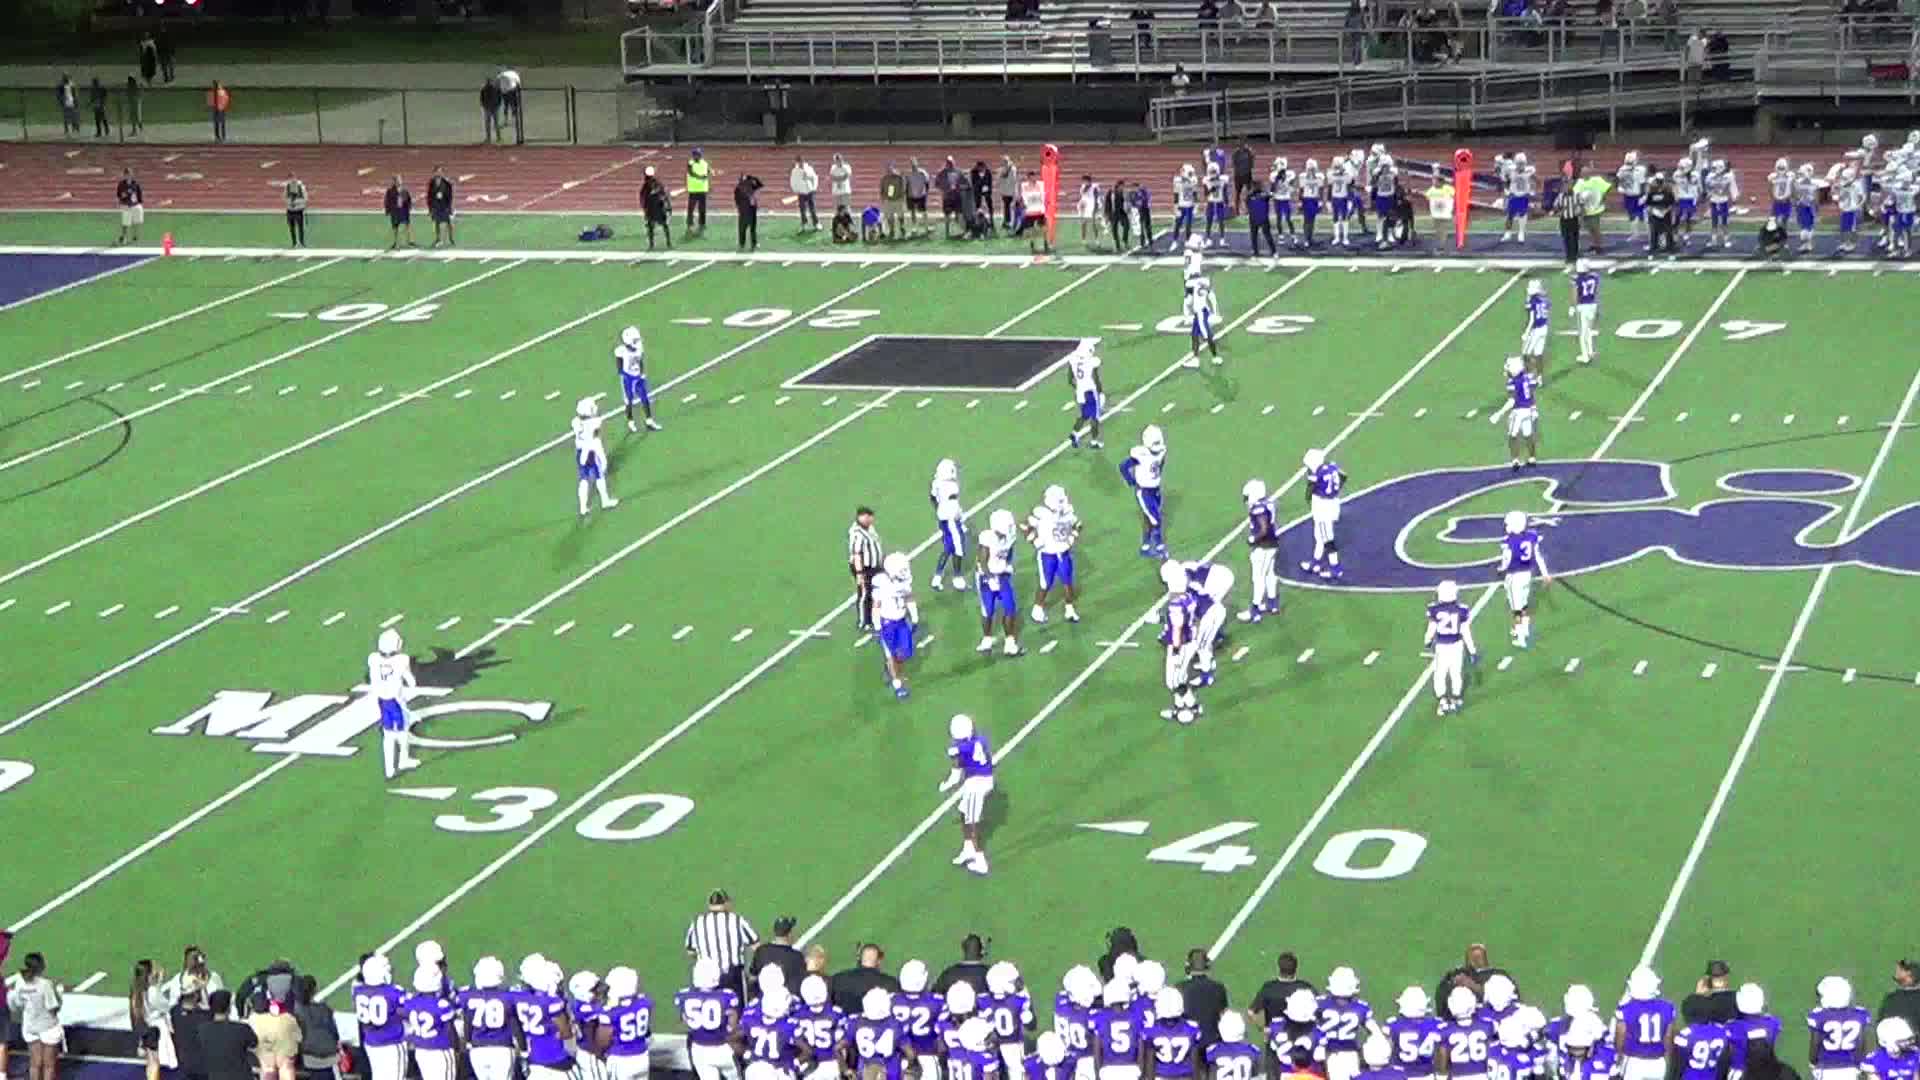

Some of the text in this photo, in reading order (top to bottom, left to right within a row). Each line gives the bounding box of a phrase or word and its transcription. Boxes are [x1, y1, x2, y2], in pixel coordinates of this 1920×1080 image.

[722, 308, 881, 328] 20
[1615, 319, 1788, 341] 40
[1275, 459, 1920, 591] Gi
[1519, 541, 1532, 561] 3
[1436, 610, 1459, 635] 21
[972, 741, 988, 766] 4
[435, 786, 695, 840] 30
[1145, 820, 1428, 880] 40
[467, 998, 504, 1029] 78
[619, 1006, 650, 1042] 58
[684, 997, 722, 1030] 50
[1320, 1008, 1359, 1040] 22
[1638, 1012, 1662, 1043] 11
[749, 1026, 780, 1059] 71
[855, 1026, 894, 1058] 64
[1110, 1020, 1131, 1053] 5
[1152, 1035, 1190, 1064] 37
[1399, 1032, 1439, 1062] 54
[1448, 1029, 1488, 1063] 26
[1822, 1020, 1861, 1051] 32
[1215, 1055, 1252, 1080] 20
